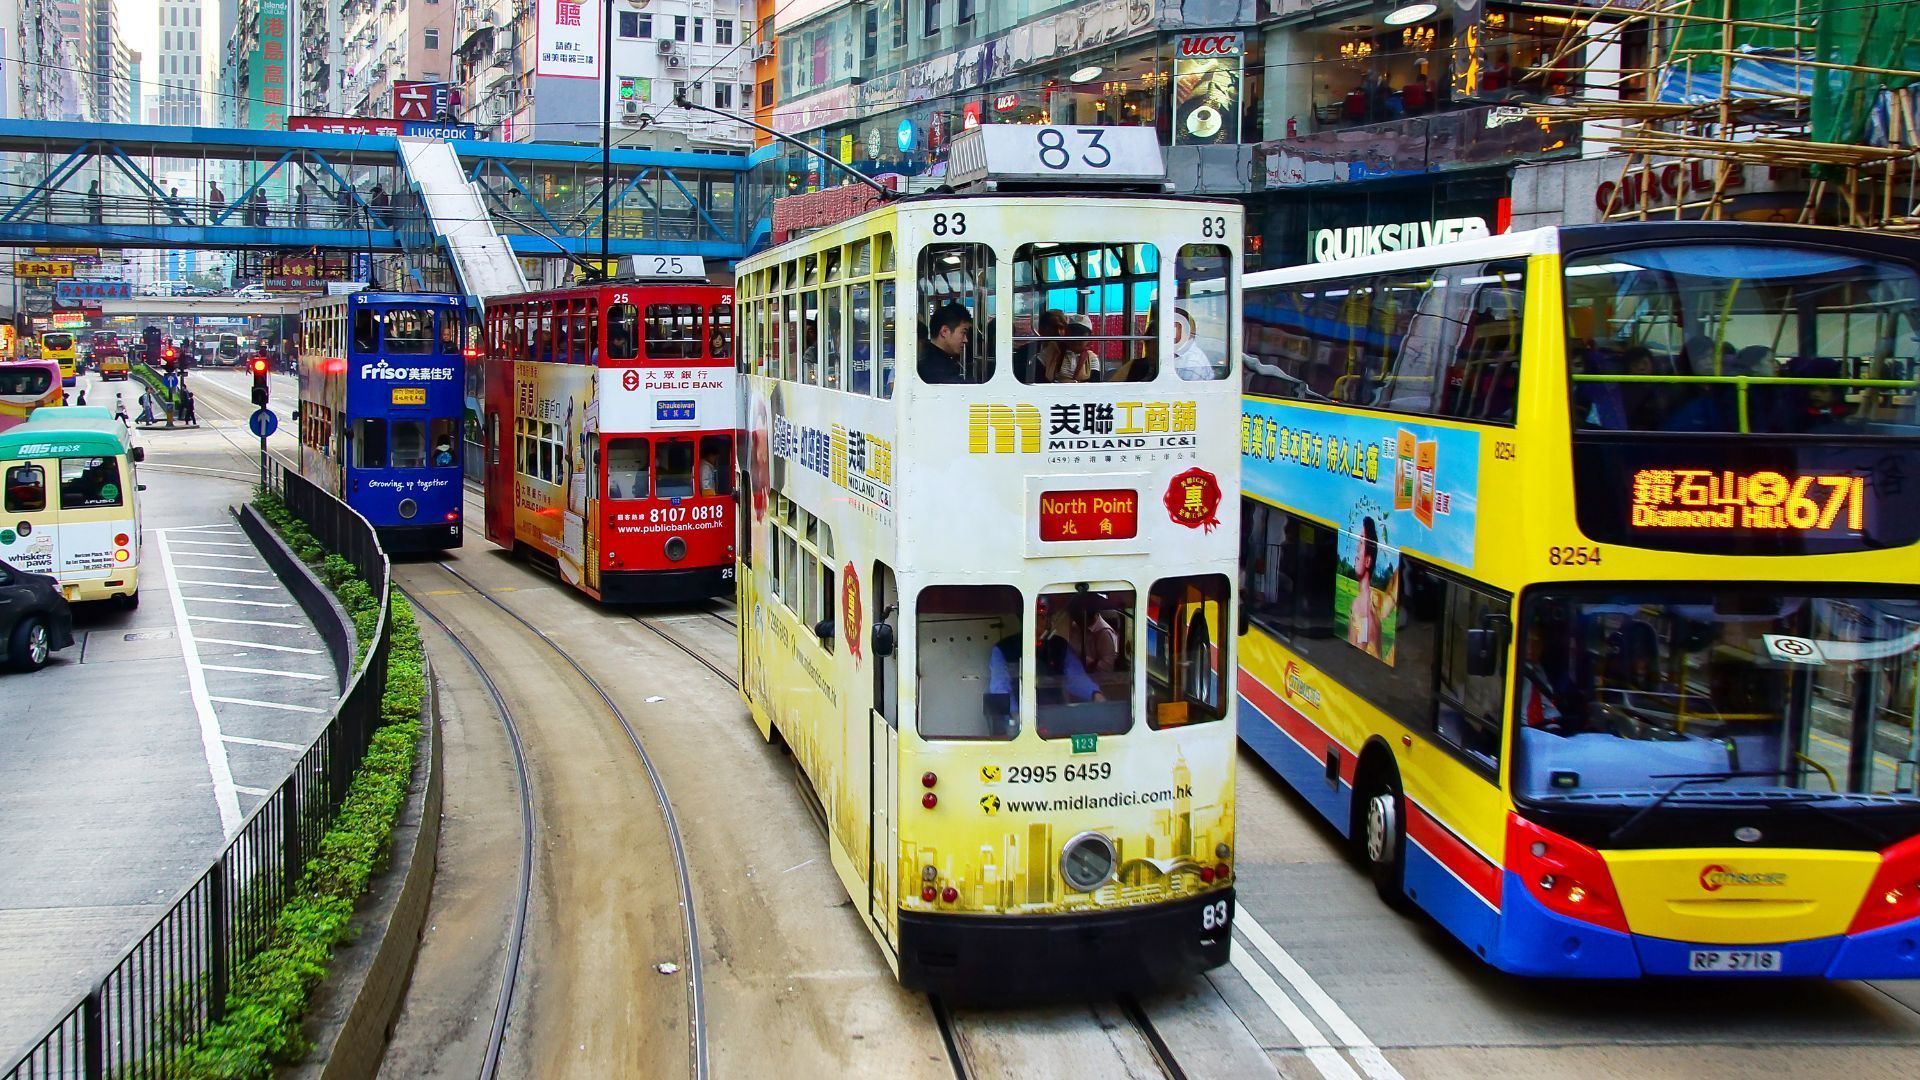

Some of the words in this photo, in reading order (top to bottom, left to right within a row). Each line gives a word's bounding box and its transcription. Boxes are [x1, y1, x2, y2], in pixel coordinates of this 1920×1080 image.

[1037, 129, 1111, 170] 83
[932, 213, 967, 236] 83
[1202, 217, 1226, 238] 83
[654, 257, 683, 274] 25
[291, 279, 302, 287] ON
[449, 297, 460, 305] 51
[614, 294, 629, 303] 25
[721, 295, 732, 304] 25
[361, 361, 408, 380] Friso
[645, 370, 708, 380] 大眾銀行
[645, 381, 689, 390] PUBLIC
[692, 381, 723, 389] BANK
[1049, 401, 1197, 435] 美聯工商舖
[18, 444, 51, 454] AMS
[1048, 437, 1146, 450] MIDLAND
[1159, 436, 1196, 447] IC&I
[1494, 441, 1516, 462] 8254
[1279, 427, 1324, 469] 草本配方
[1325, 433, 1381, 483] 持久止痛
[369, 480, 404, 492] Growing
[406, 481, 414, 490] up
[417, 479, 448, 491] together
[848, 475, 875, 499] MIDLAND
[1042, 498, 1087, 514] North
[1093, 497, 1132, 514] Point
[1785, 475, 1864, 530] 671
[650, 507, 686, 522] 8107
[692, 505, 723, 520] 0818
[1632, 505, 1734, 527] Diamond
[1742, 506, 1788, 528] Hill
[450, 526, 459, 534] 51
[617, 520, 723, 534] www.publicbank.com.hk
[1062, 518, 1113, 535] 北角
[8, 553, 52, 562] whiskers
[26, 560, 52, 569] paws
[1549, 547, 1601, 566] 8254
[722, 568, 733, 579] 25
[1075, 738, 1094, 749] 123
[1007, 765, 1057, 783] 2995
[1063, 762, 1111, 781] 6459
[1007, 784, 1193, 813] www.midlandici.com.hk
[1203, 900, 1227, 930] 83
[1694, 952, 1720, 968] RP
[1728, 952, 1773, 968] 5718
